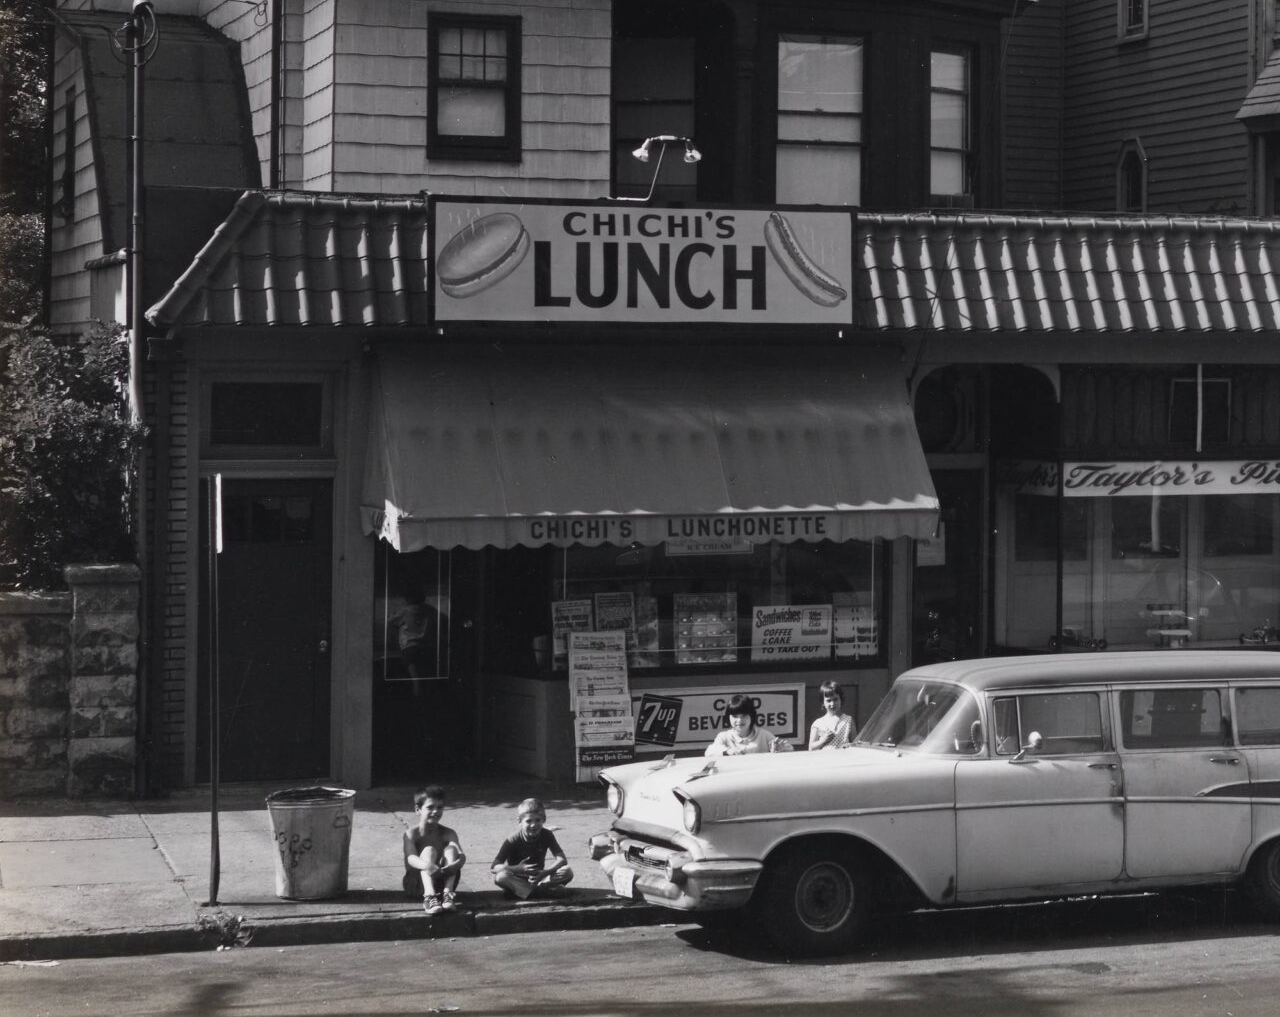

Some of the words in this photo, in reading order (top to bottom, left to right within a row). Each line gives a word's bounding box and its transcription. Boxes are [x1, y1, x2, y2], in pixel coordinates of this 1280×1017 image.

[562, 211, 736, 240] CHICHI'S
[533, 240, 767, 311] LUNCH
[1064, 463, 1215, 495] Taylor's
[530, 519, 633, 540] CHICHI'S
[667, 516, 827, 538] LUNCHONETTE
[755, 607, 801, 629] Sandwiches
[763, 628, 793, 637] COFFEE
[768, 636, 792, 645] CAKE
[801, 645, 820, 653] OUT
[713, 697, 762, 712] CD
[688, 712, 788, 731] BEVEGES
[582, 754, 592, 762] The
[604, 753, 616, 762] York
[617, 752, 633, 760] Times
